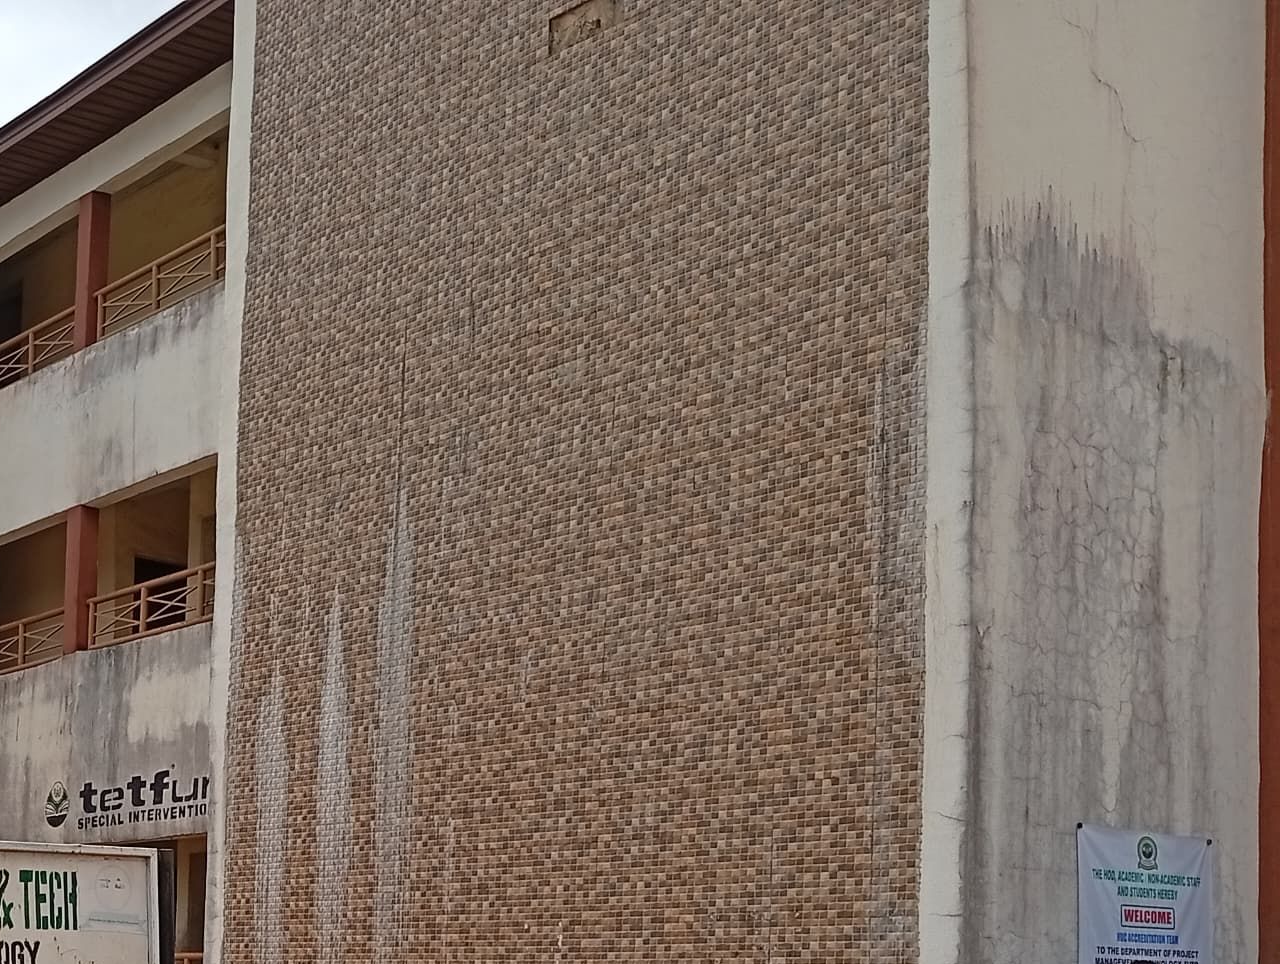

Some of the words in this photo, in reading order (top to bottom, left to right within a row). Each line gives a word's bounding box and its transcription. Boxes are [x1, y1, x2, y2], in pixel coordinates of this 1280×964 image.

[79, 768, 209, 814] tetfu
[77, 814, 124, 830] SPECIAL
[128, 803, 207, 824] INTERVENTIO
[19, 869, 79, 931] TECH
[1129, 887, 1156, 899] STUDENTS
[1157, 889, 1178, 900] HEREBY
[1123, 908, 1173, 925] WELCOME
[1096, 946, 1106, 955] TO
[1107, 947, 1120, 956] THE
[1120, 948, 1162, 958] DEPARTMENT
[1163, 950, 1171, 958] OF
[1172, 950, 1199, 959] PROJECT
